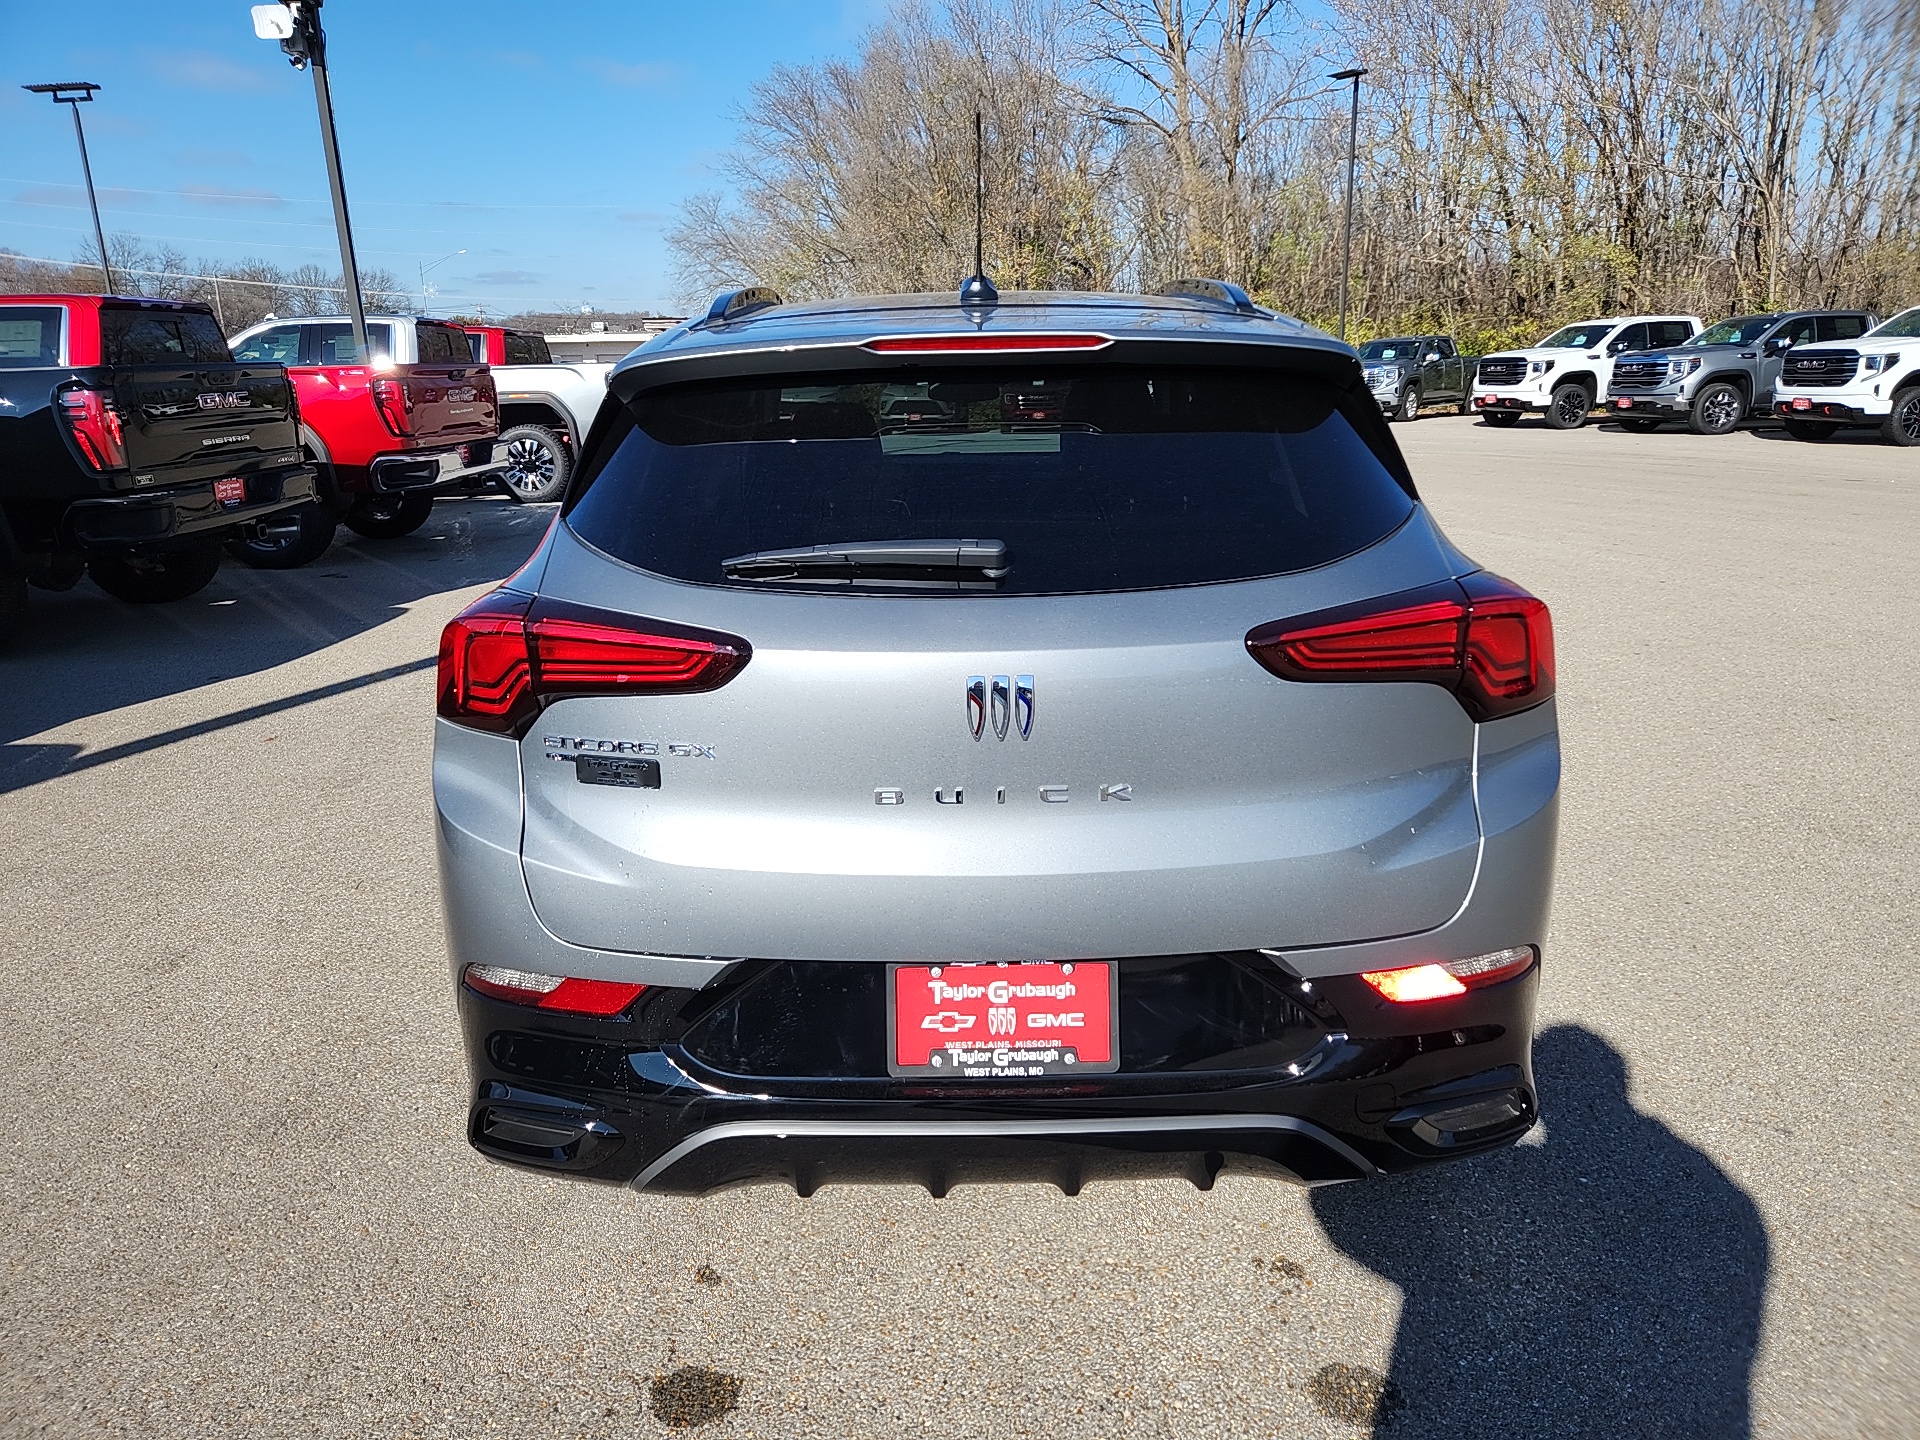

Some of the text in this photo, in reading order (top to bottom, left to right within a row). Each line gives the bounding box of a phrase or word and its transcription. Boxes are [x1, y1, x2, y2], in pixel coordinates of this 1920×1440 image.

[198, 391, 252, 410] GMC
[202, 434, 251, 446] SIERRA
[543, 735, 717, 761] ENCORE GX
[873, 782, 1134, 806] BUICK
[927, 979, 1077, 1005] Taylor Grubaugh
[1026, 1012, 1086, 1027] GMC
[944, 1041, 973, 1049] WEST
[1014, 1039, 1062, 1049] MISSOURI
[947, 1048, 1060, 1067] Taylor Grubaugh
[963, 1066, 1044, 1078] WEST PLAINS, MO
